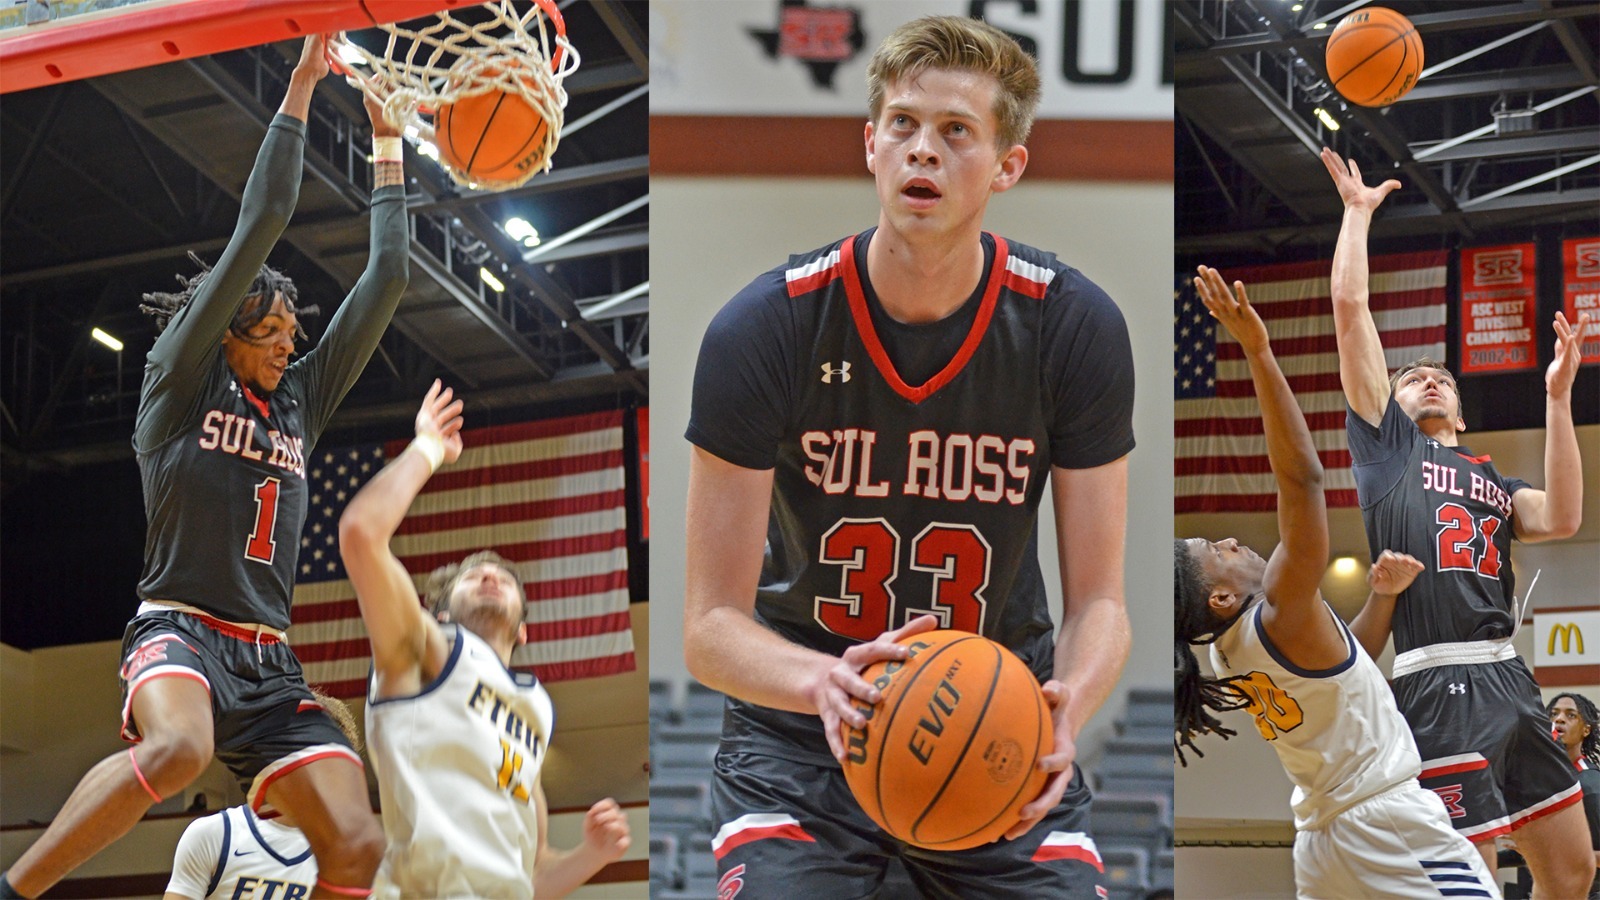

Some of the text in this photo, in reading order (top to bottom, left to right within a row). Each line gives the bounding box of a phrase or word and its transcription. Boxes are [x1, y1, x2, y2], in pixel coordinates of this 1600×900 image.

[967, 0, 1174, 84] SU
[1476, 256, 1520, 280] SR
[1471, 300, 1525, 317] ASC WEST
[1574, 294, 1597, 308] ASC
[1466, 328, 1531, 346] CHAMPIONS
[1473, 315, 1523, 331] DIVISION
[1469, 347, 1529, 366] 2002-03
[199, 410, 263, 461] SUL
[801, 428, 1036, 506] SUL ROSS
[1422, 461, 1464, 497] SUL
[244, 476, 281, 566] 1
[1436, 502, 1502, 581] 21
[813, 517, 993, 643] 33
[908, 658, 963, 767] EVO NXT
